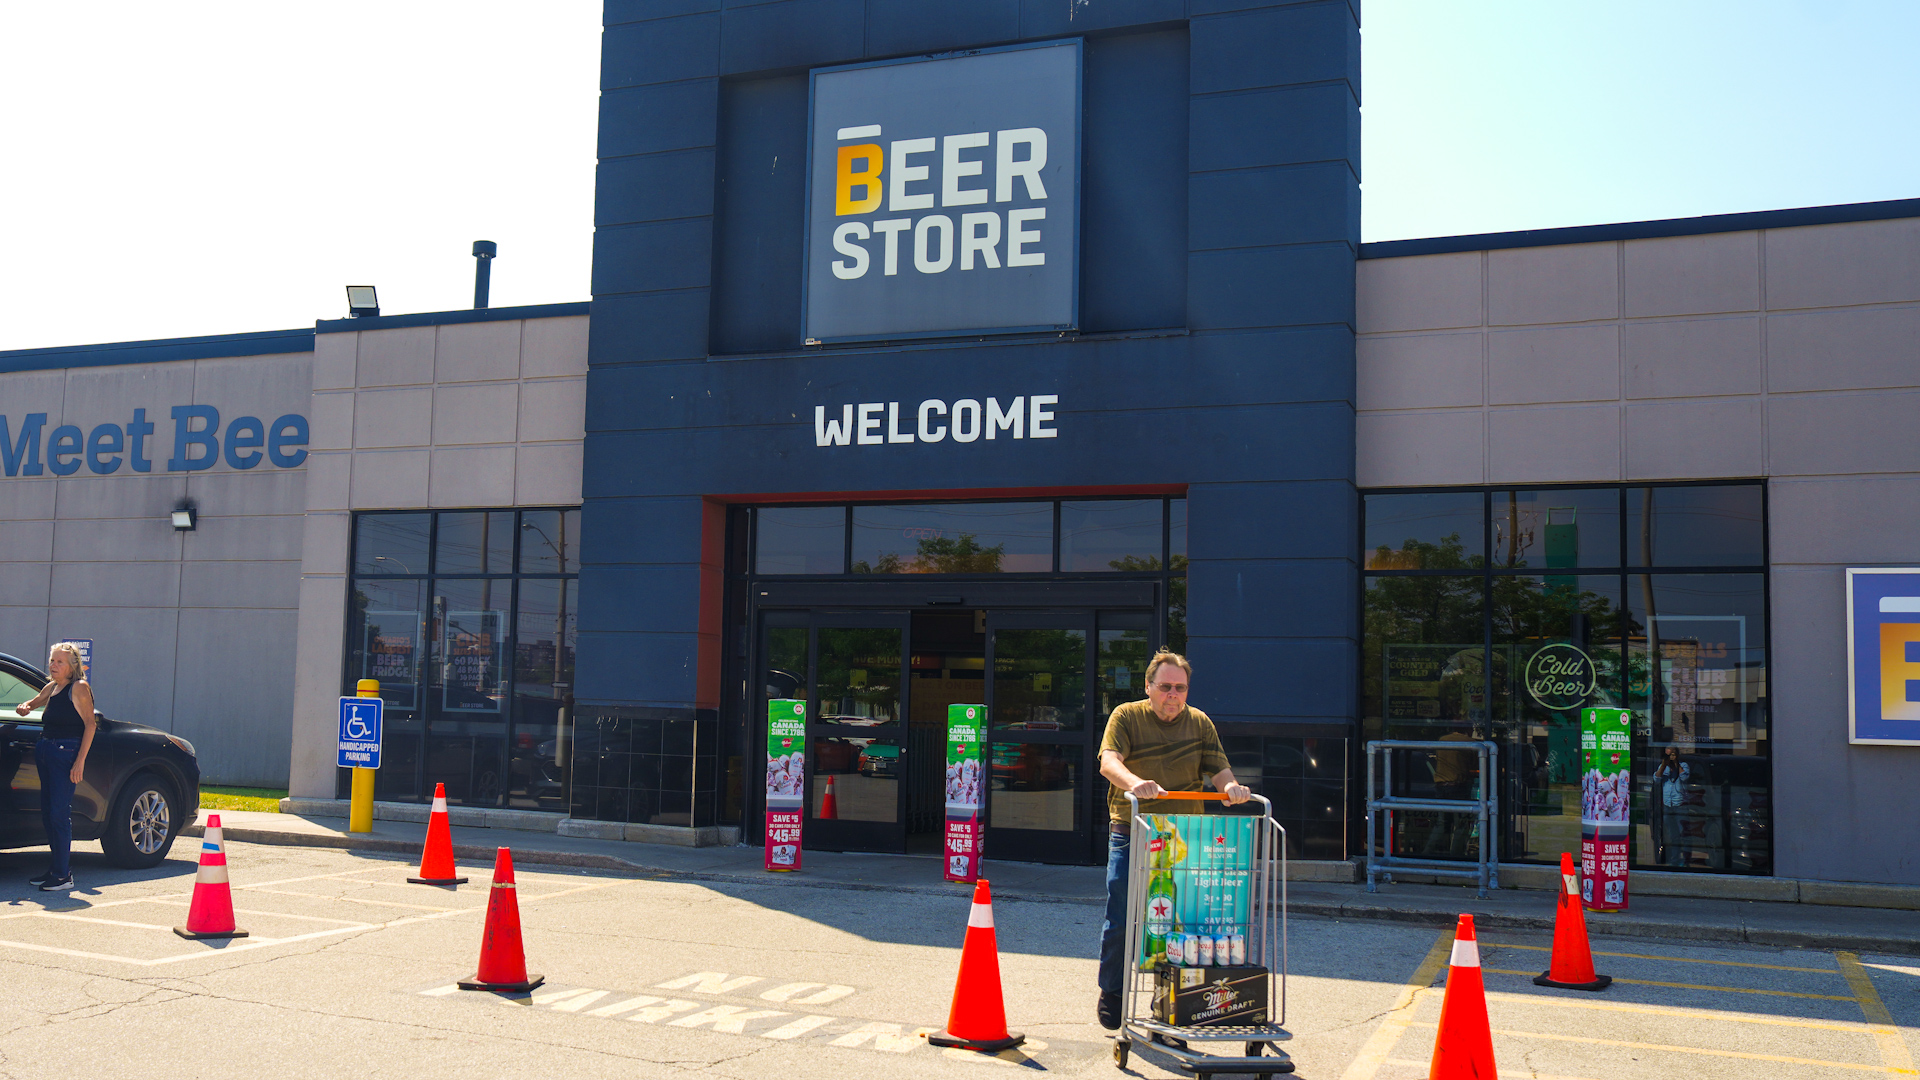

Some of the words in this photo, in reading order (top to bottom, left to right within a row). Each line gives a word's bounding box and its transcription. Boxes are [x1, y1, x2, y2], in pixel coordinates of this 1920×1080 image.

[835, 126, 1048, 216] BEER
[831, 207, 1046, 280] STORE
[815, 394, 1059, 446] WELCOME
[0, 408, 154, 476] Meet
[902, 527, 943, 540] OPEN
[455, 633, 491, 647] CLUB
[371, 643, 412, 654] LARGEST
[1664, 642, 1728, 658] DEALS
[376, 653, 405, 666] BEER
[454, 656, 466, 666] 60
[467, 656, 491, 666] PACK
[1389, 661, 1440, 670] COUNTRY
[1537, 654, 1585, 676] Cold
[371, 665, 412, 678] FRIDGE.
[457, 666, 467, 674] 48
[468, 665, 488, 674] PACK
[1400, 669, 1429, 677] GOLD
[1664, 667, 1728, 687] CLUB
[1534, 674, 1588, 697] Beer
[1670, 687, 1723, 705] SIZES
[1673, 704, 1692, 712] ARE
[771, 721, 805, 729] CANADA
[771, 728, 789, 736] SINCE
[963, 734, 976, 742] 1786
[1601, 734, 1630, 742] CANADA
[339, 741, 379, 752] HANDICAPPED
[1601, 741, 1617, 750] SINCE
[1617, 742, 1630, 751] 1786
[345, 752, 371, 762] PARKING
[772, 814, 790, 823] SAVE
[791, 814, 799, 823] $5
[950, 823, 964, 832] SAVE
[964, 824, 971, 833] $5
[768, 828, 800, 843] $45.99
[947, 838, 973, 853] $45.99
[1604, 844, 1619, 853] SAVE
[1619, 844, 1626, 854] $5
[1601, 860, 1628, 877] $45.99
[1194, 877, 1219, 888] Light
[1220, 878, 1243, 887] Beer
[1167, 943, 1182, 957] Coors
[1182, 975, 1191, 983] 24
[654, 971, 856, 1004] NO
[1203, 990, 1240, 1008] Miller
[1191, 1006, 1226, 1021] GENUINE
[1227, 1000, 1253, 1012] DRAFT
